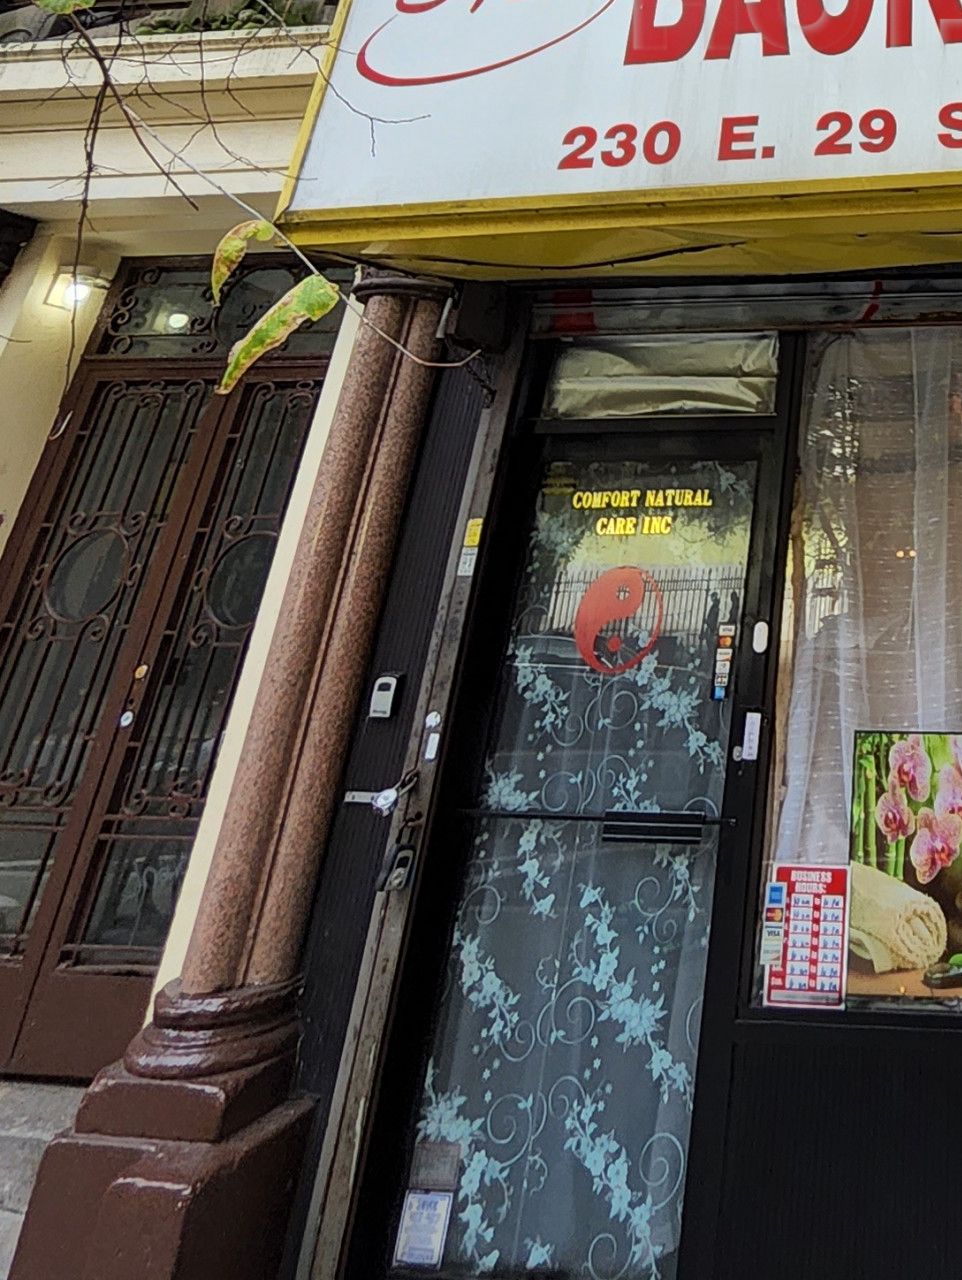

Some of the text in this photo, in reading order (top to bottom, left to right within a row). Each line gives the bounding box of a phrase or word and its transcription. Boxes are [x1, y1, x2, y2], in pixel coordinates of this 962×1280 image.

[558, 123, 682, 170] 230
[717, 114, 776, 162] E.
[813, 107, 897, 156] 29
[572, 489, 713, 509] COMFORT NATURAL
[596, 516, 673, 536] CARE INC
